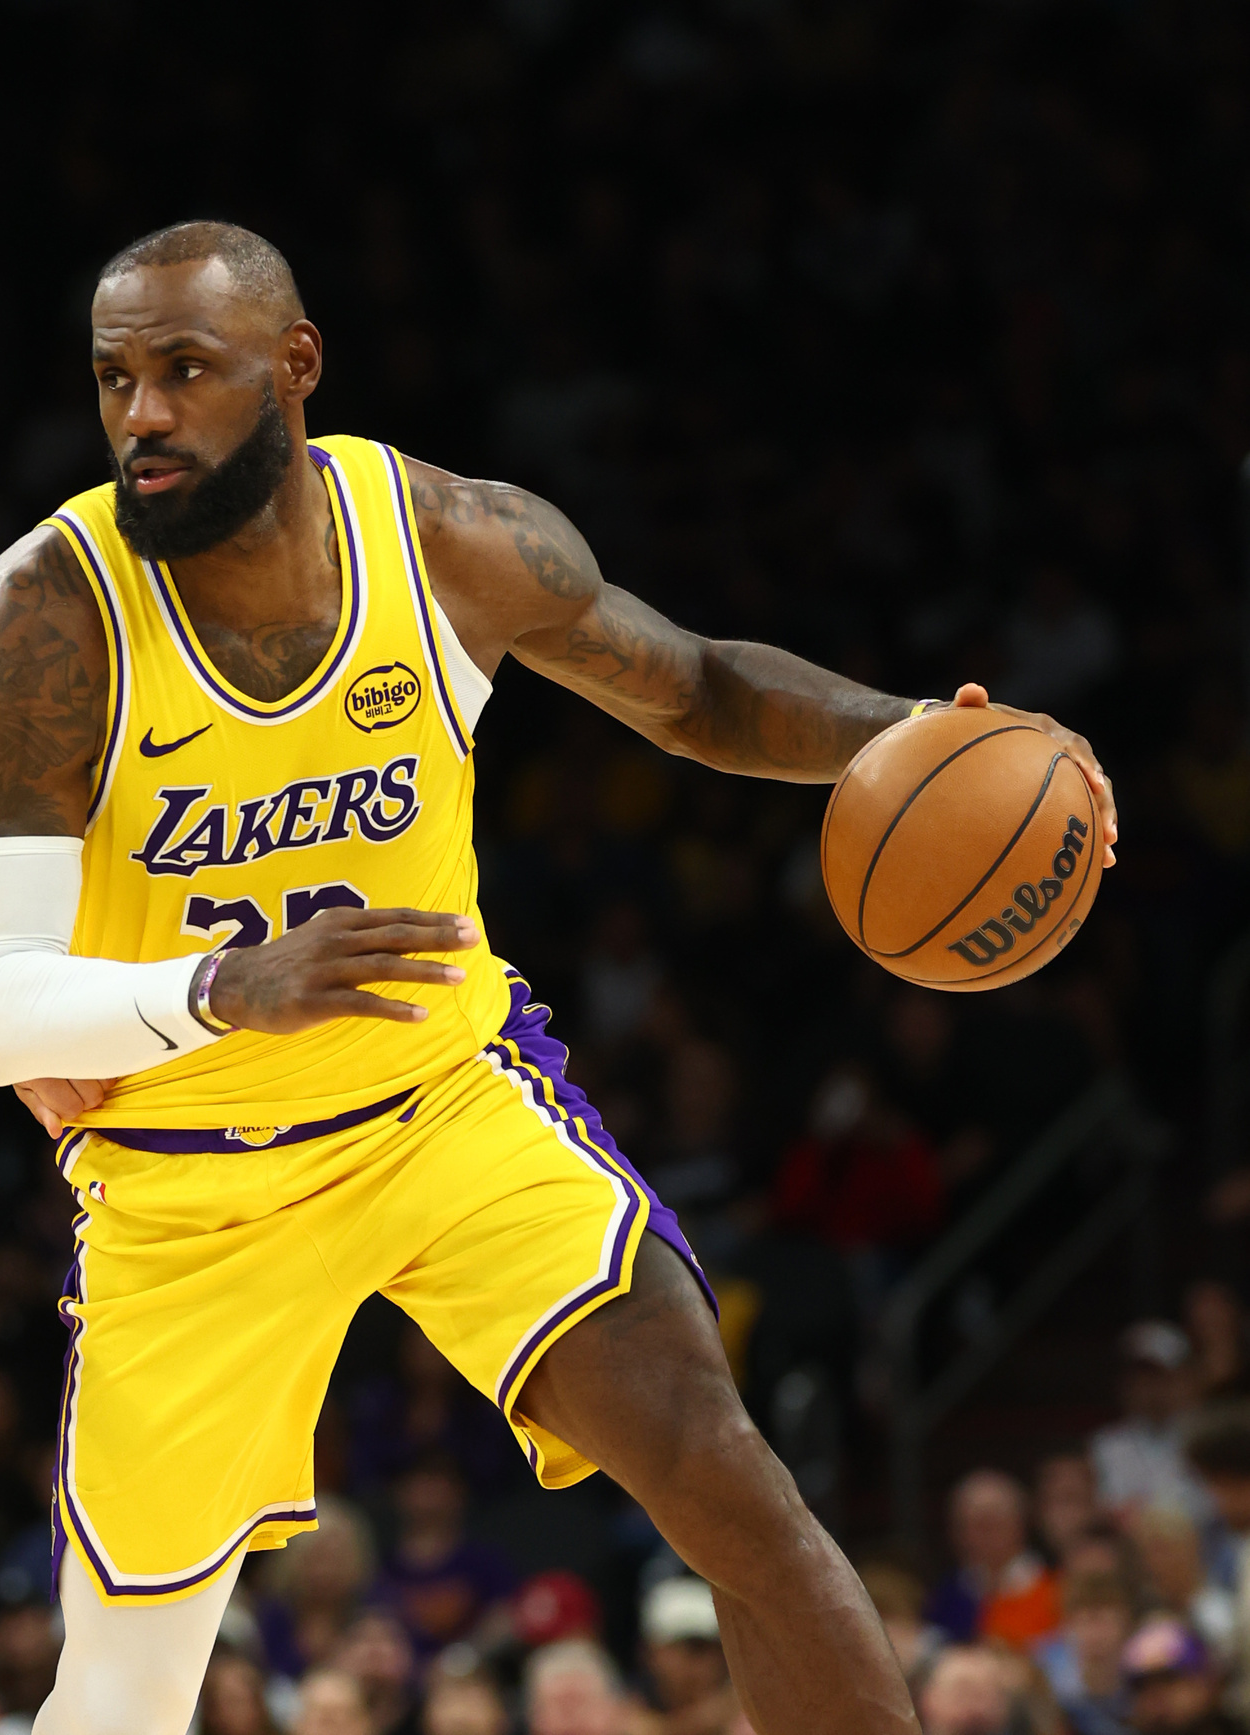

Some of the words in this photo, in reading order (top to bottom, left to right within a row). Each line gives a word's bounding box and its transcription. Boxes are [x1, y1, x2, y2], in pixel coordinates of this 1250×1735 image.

[351, 681, 416, 711] bibigo
[365, 703, 393, 718] 비비고
[128, 754, 424, 879] LAKERS
[945, 814, 1089, 967] Wilson
